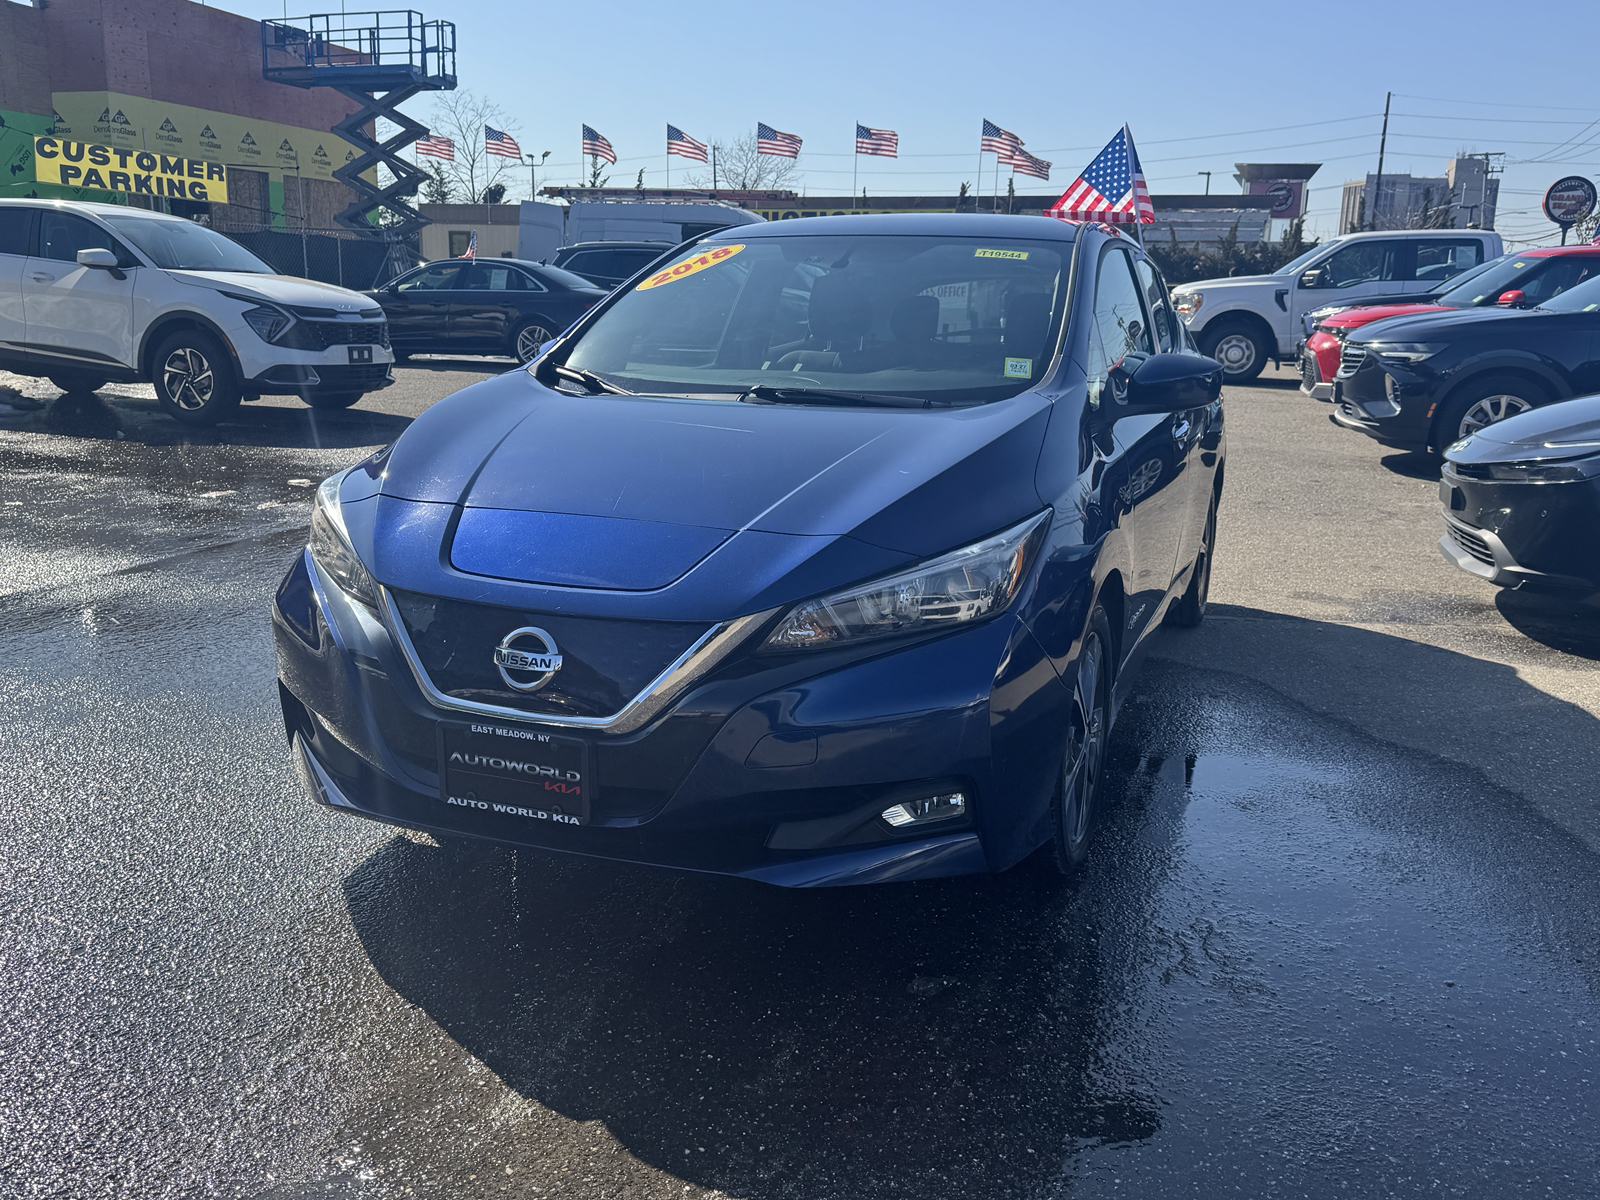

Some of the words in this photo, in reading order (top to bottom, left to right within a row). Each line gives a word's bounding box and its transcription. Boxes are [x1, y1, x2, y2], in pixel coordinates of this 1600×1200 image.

[54, 126, 72, 134] Glass
[112, 126, 137, 137] ensGlass
[155, 132, 183, 144] DensGlass
[199, 140, 222, 150] ensGlass
[36, 137, 225, 182] CUSTOMER
[60, 164, 208, 201] PARKING
[651, 247, 733, 286] 2018
[937, 285, 966, 298] OFFICE
[496, 652, 552, 669] NISSAN
[471, 724, 493, 735] EAST
[538, 734, 550, 743] NY
[449, 751, 581, 783] AUTOWORLD
[544, 781, 581, 796] KIA
[447, 796, 488, 810] AUTO
[493, 803, 548, 820] WORLD
[552, 813, 581, 826] KIA
